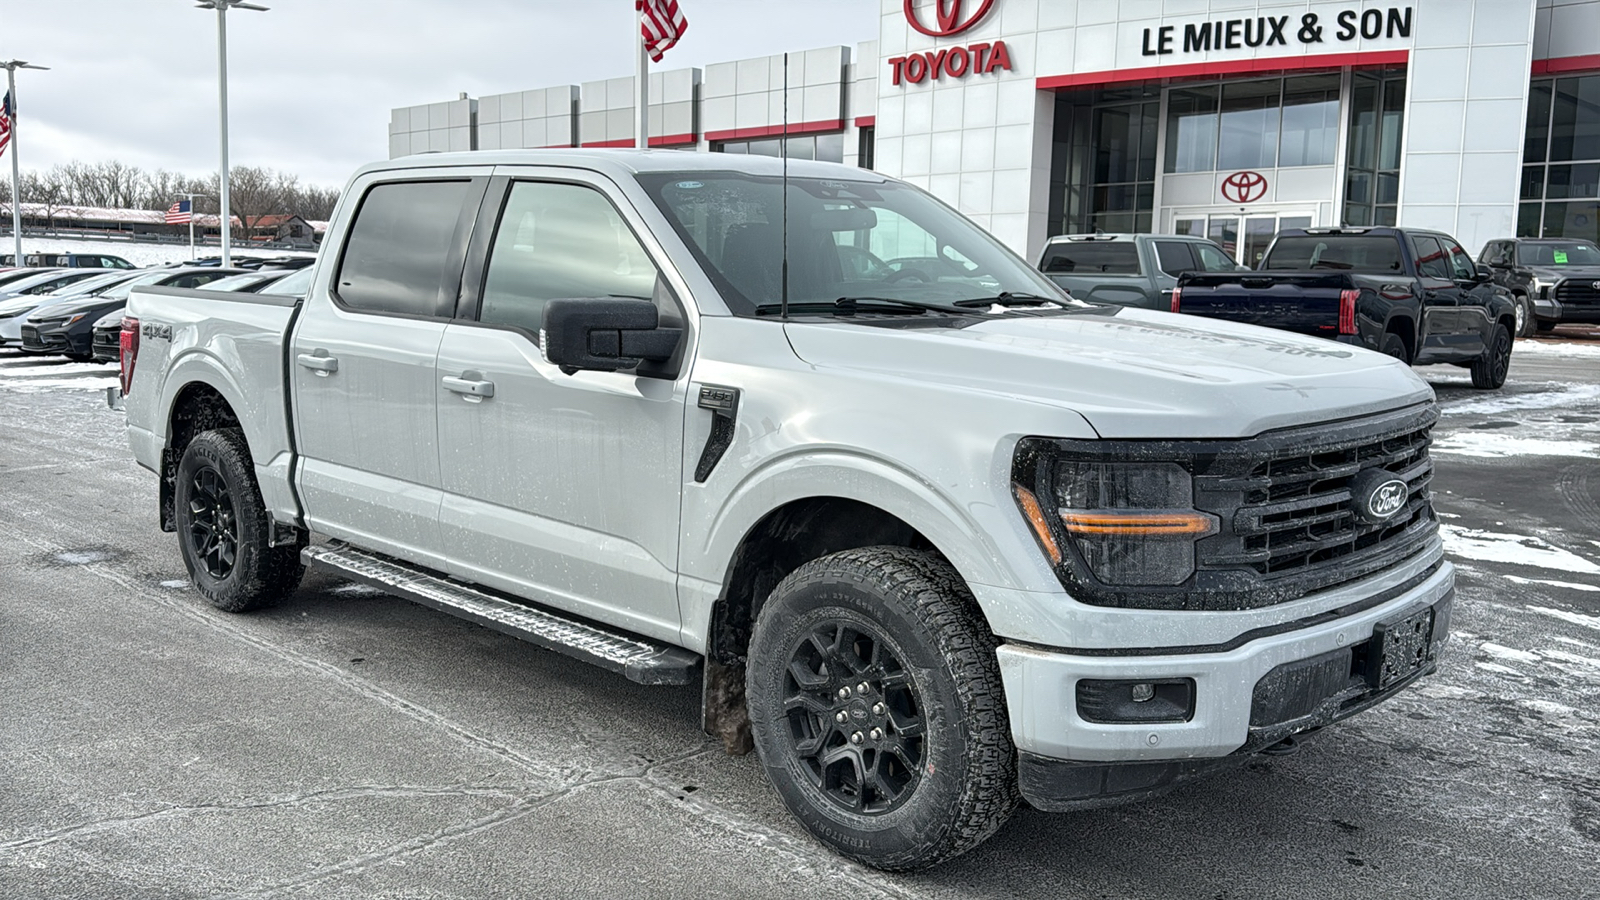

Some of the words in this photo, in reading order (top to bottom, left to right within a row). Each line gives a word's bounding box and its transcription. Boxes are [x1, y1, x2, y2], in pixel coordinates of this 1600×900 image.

[1141, 26, 1173, 57] LE
[1183, 15, 1288, 53] MIEUX
[1298, 13, 1322, 44] &
[1336, 7, 1412, 39] SON
[888, 40, 1011, 86] TOYOTA
[1376, 485, 1402, 512] Ford
